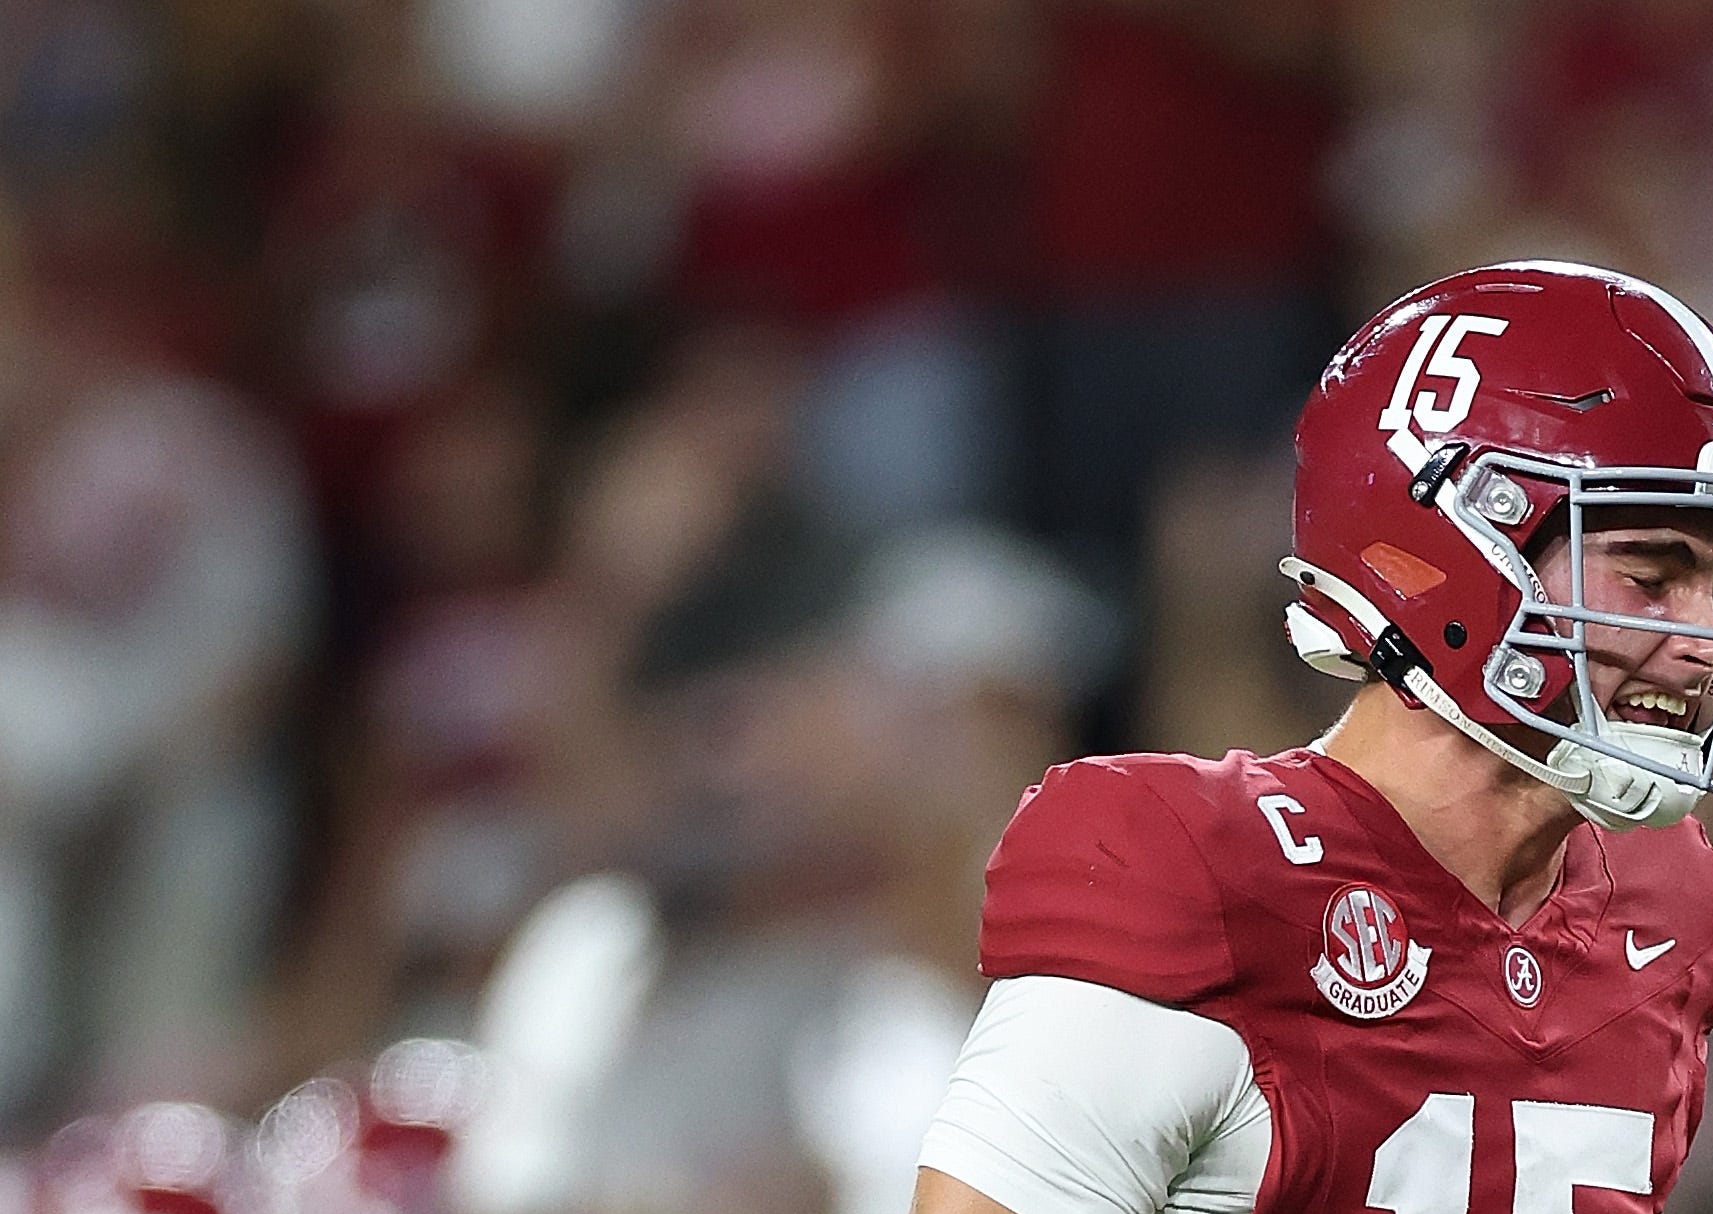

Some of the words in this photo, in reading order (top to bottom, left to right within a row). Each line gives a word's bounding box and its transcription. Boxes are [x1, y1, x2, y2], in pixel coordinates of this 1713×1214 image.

[1377, 314, 1510, 434] 15
[1257, 793, 1324, 865] C
[1331, 888, 1402, 982] SEC
[1328, 968, 1421, 1015] GRADUATE
